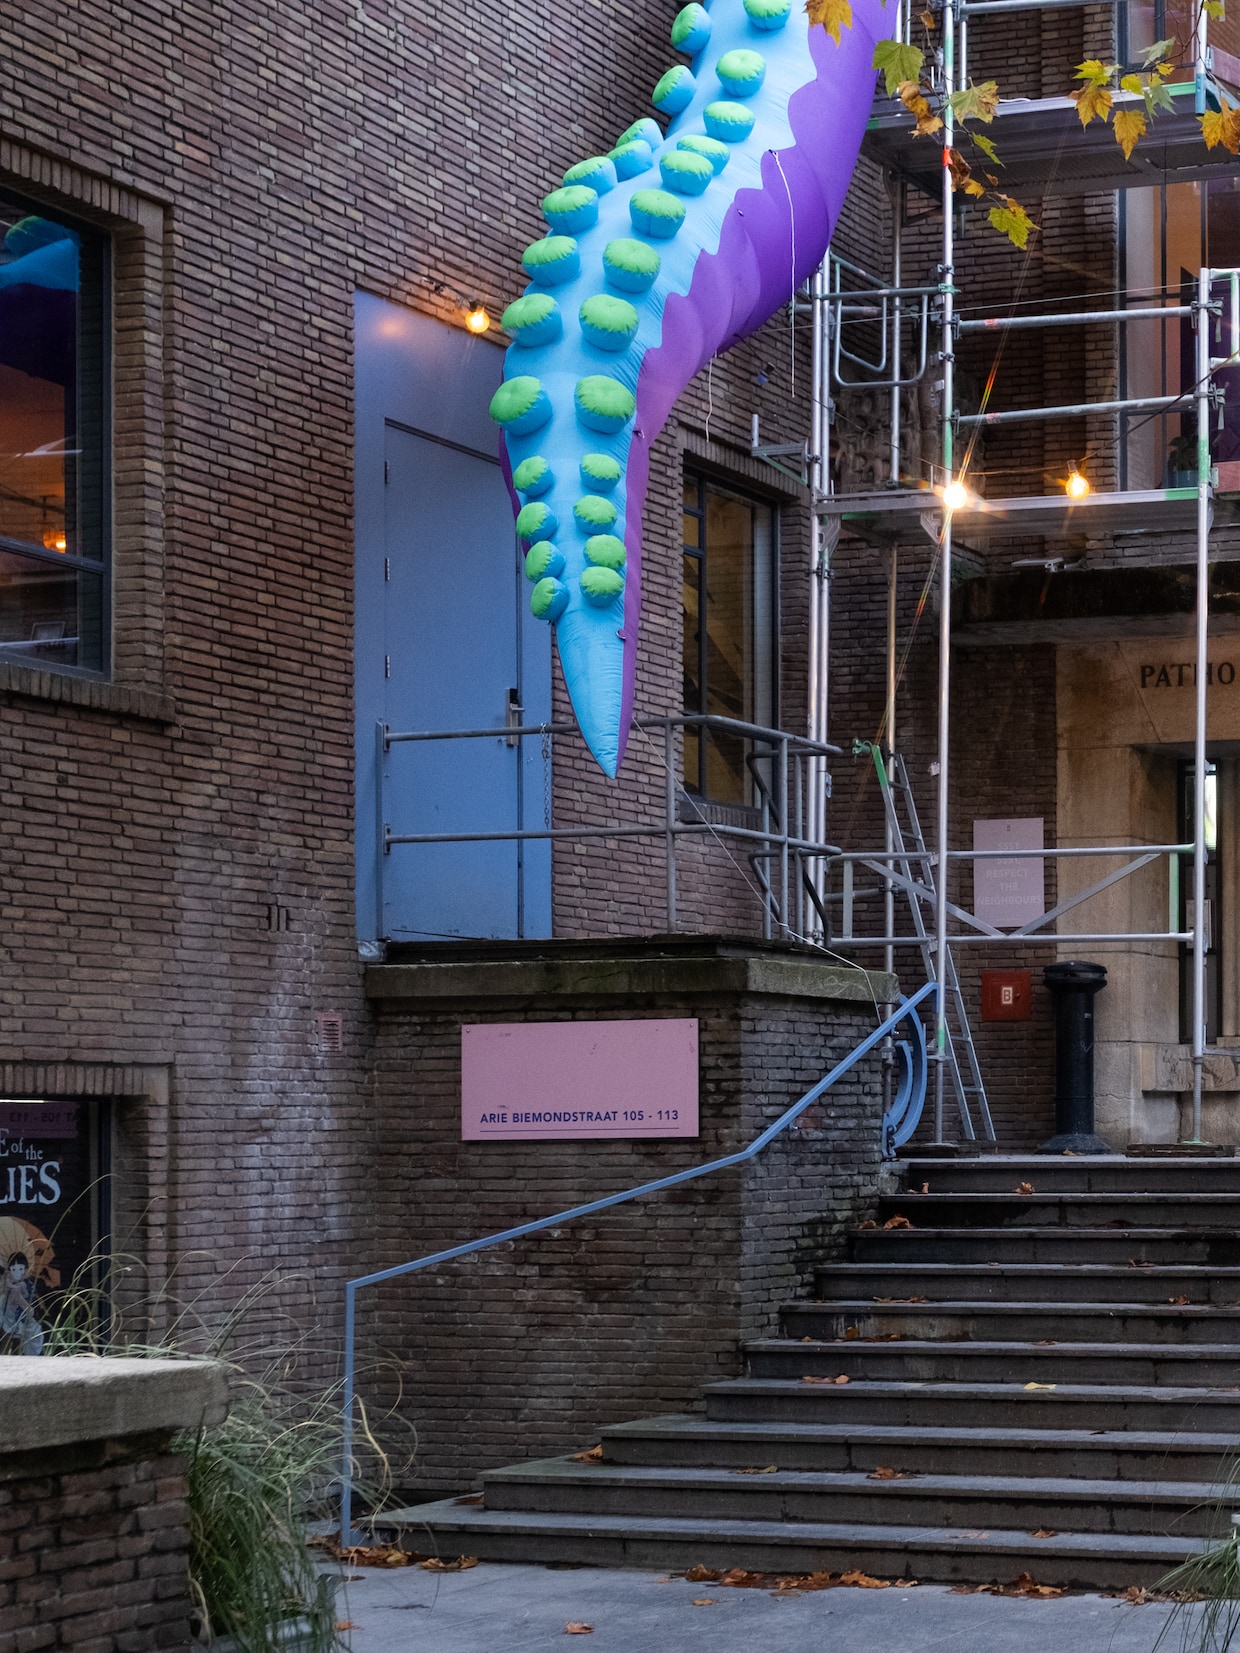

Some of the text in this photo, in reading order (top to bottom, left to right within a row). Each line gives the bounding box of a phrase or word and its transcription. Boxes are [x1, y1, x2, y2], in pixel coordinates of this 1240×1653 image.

[985, 868, 1028, 879] RESPECT
[999, 882, 1019, 892] THE
[977, 895, 1042, 906] NEIGHBOURS
[480, 1112, 508, 1124] ARIE
[512, 1110, 618, 1123] BIEMONDSTRAAT
[623, 1110, 644, 1121] 105
[657, 1109, 679, 1121] 113
[11, 1138, 25, 1154] of
[25, 1144, 43, 1160] the
